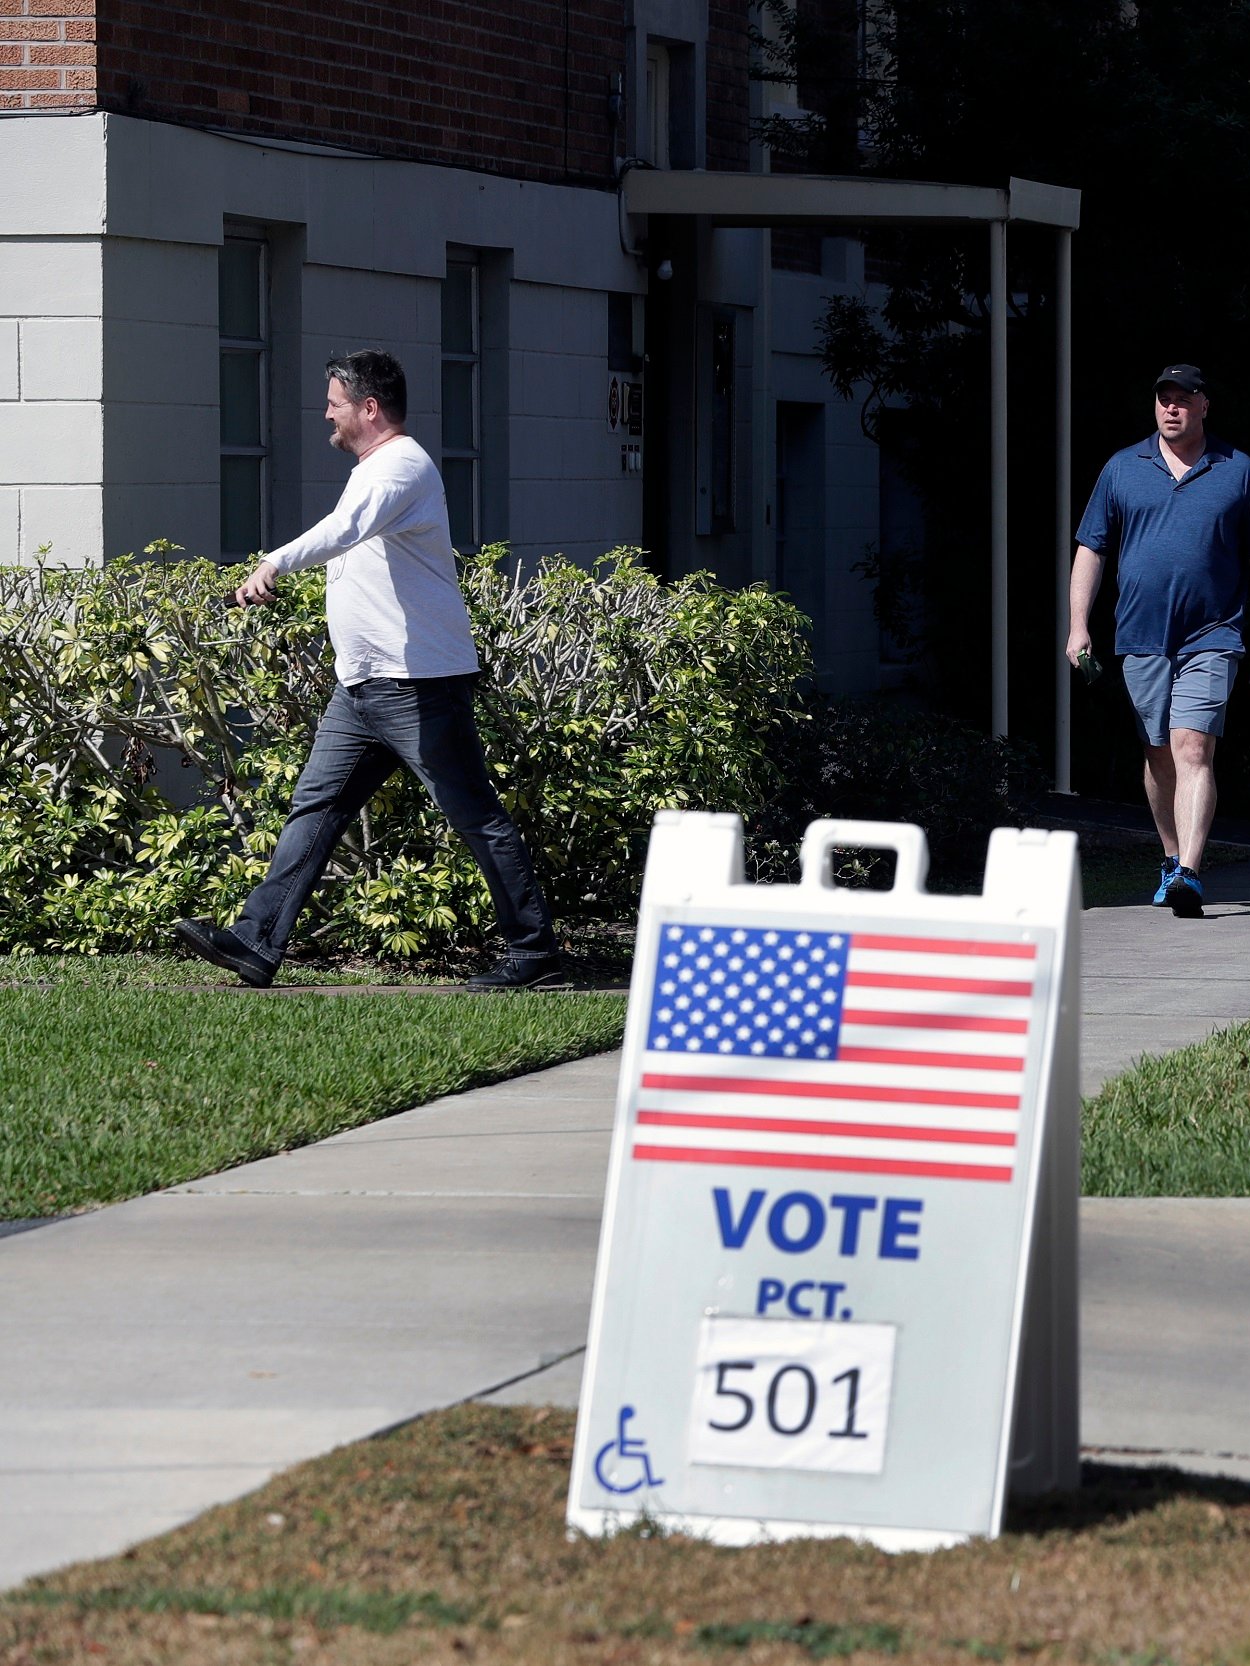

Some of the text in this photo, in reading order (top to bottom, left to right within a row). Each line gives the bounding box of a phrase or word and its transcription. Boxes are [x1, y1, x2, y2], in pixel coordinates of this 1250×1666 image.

[712, 1187, 924, 1261] VOTE
[755, 1278, 853, 1321] PCT.
[707, 1361, 869, 1440] 501
